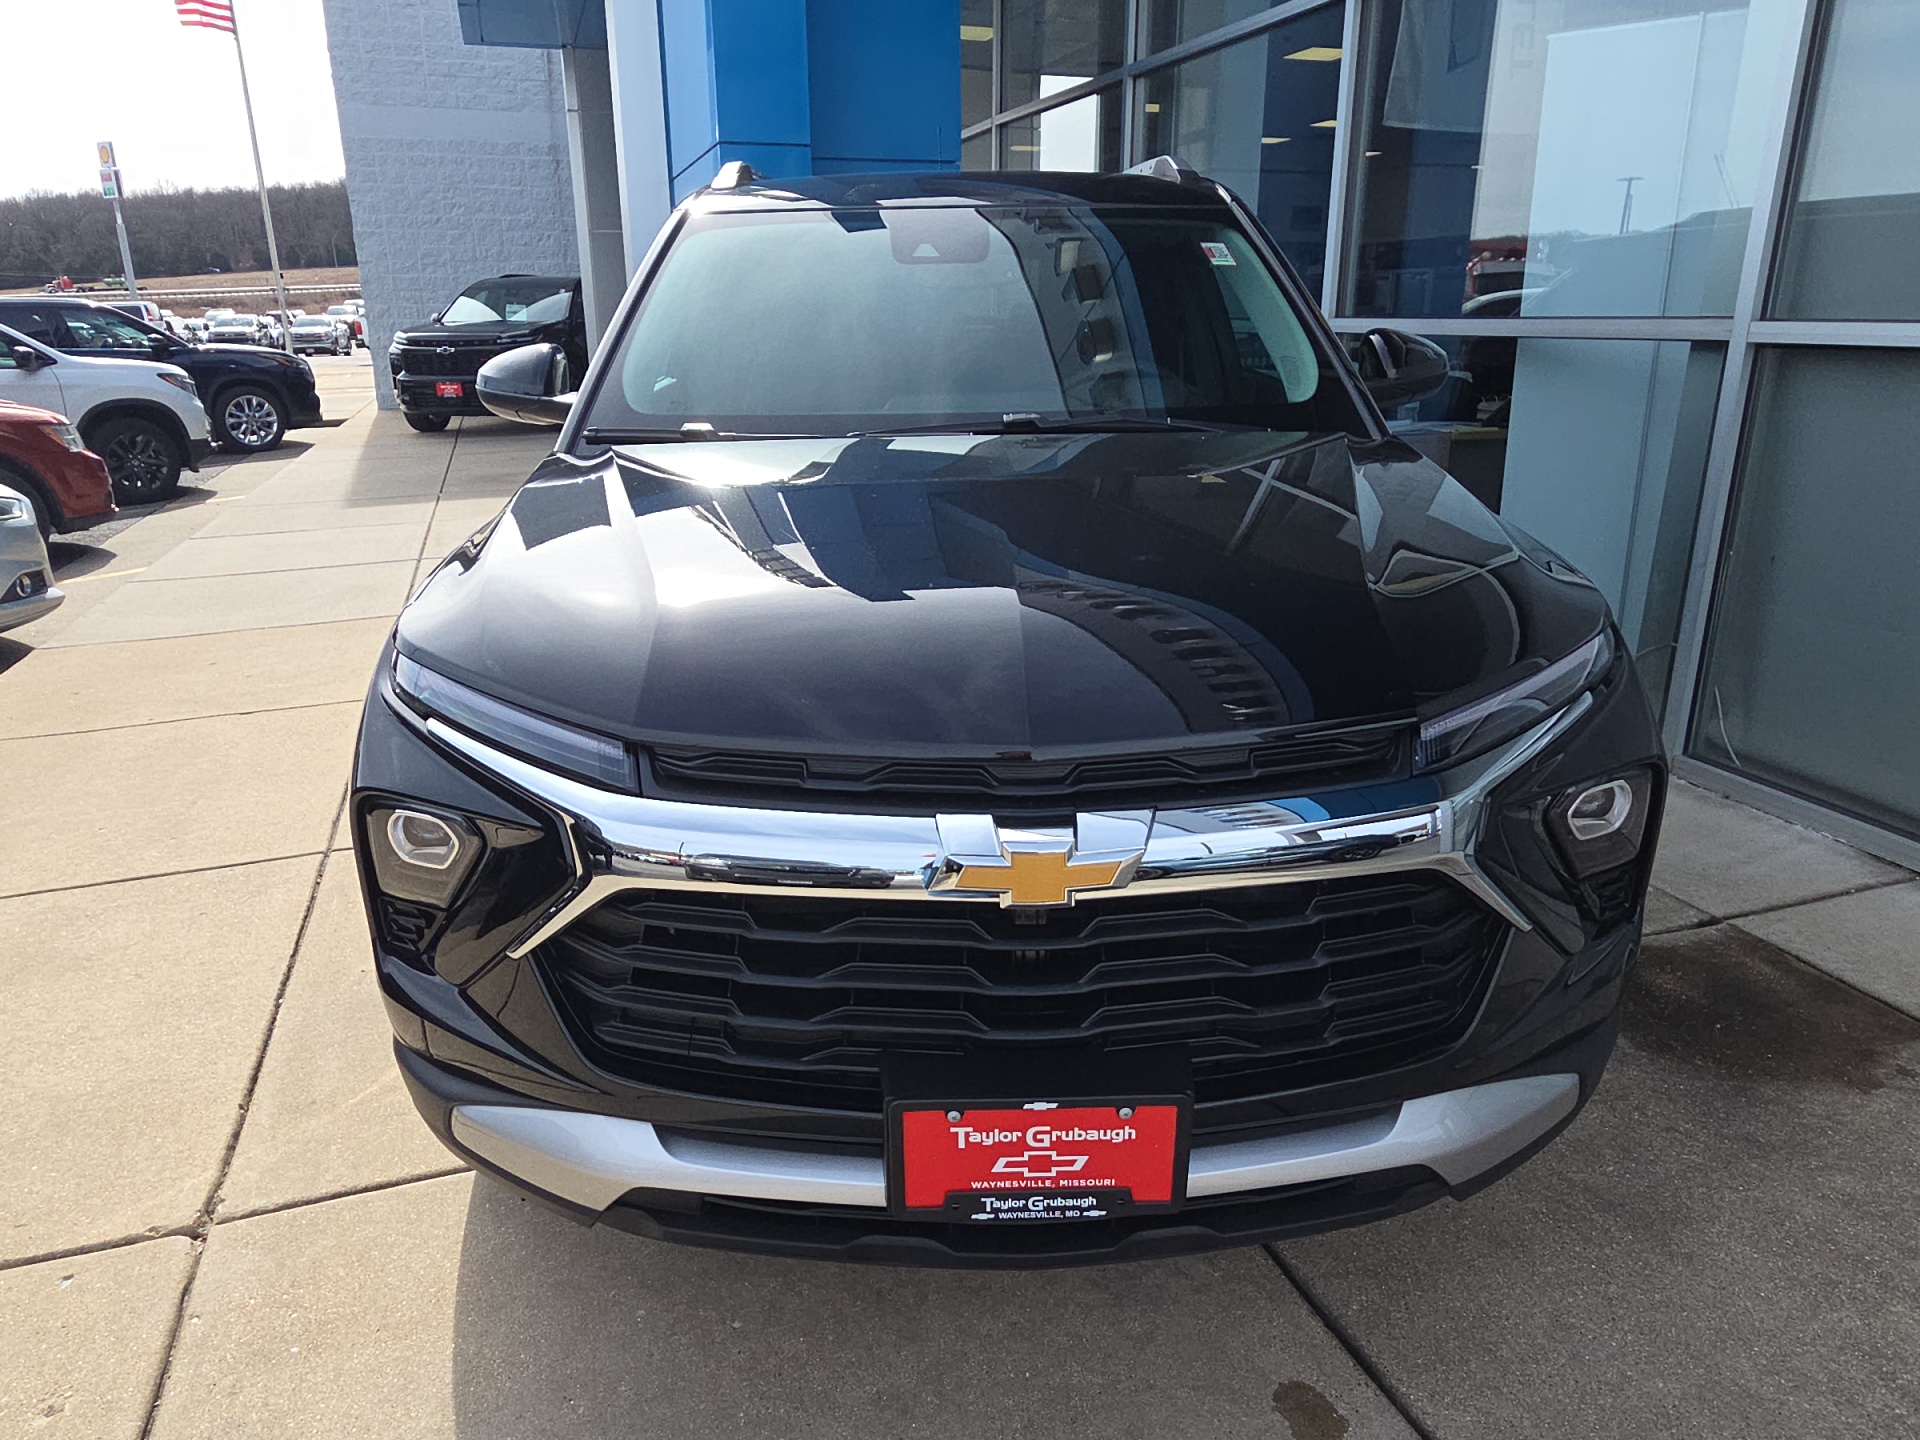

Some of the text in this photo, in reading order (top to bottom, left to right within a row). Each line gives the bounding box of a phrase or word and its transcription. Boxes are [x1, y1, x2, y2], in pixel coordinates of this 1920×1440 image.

[950, 1125, 1136, 1149] Taylor Grubaugh
[971, 1178, 1116, 1189] WAYNESVILLE, MISSOURI
[981, 1196, 1097, 1212] Taylor Grubaugh
[998, 1211, 1064, 1219] WAYNESVILLE,
